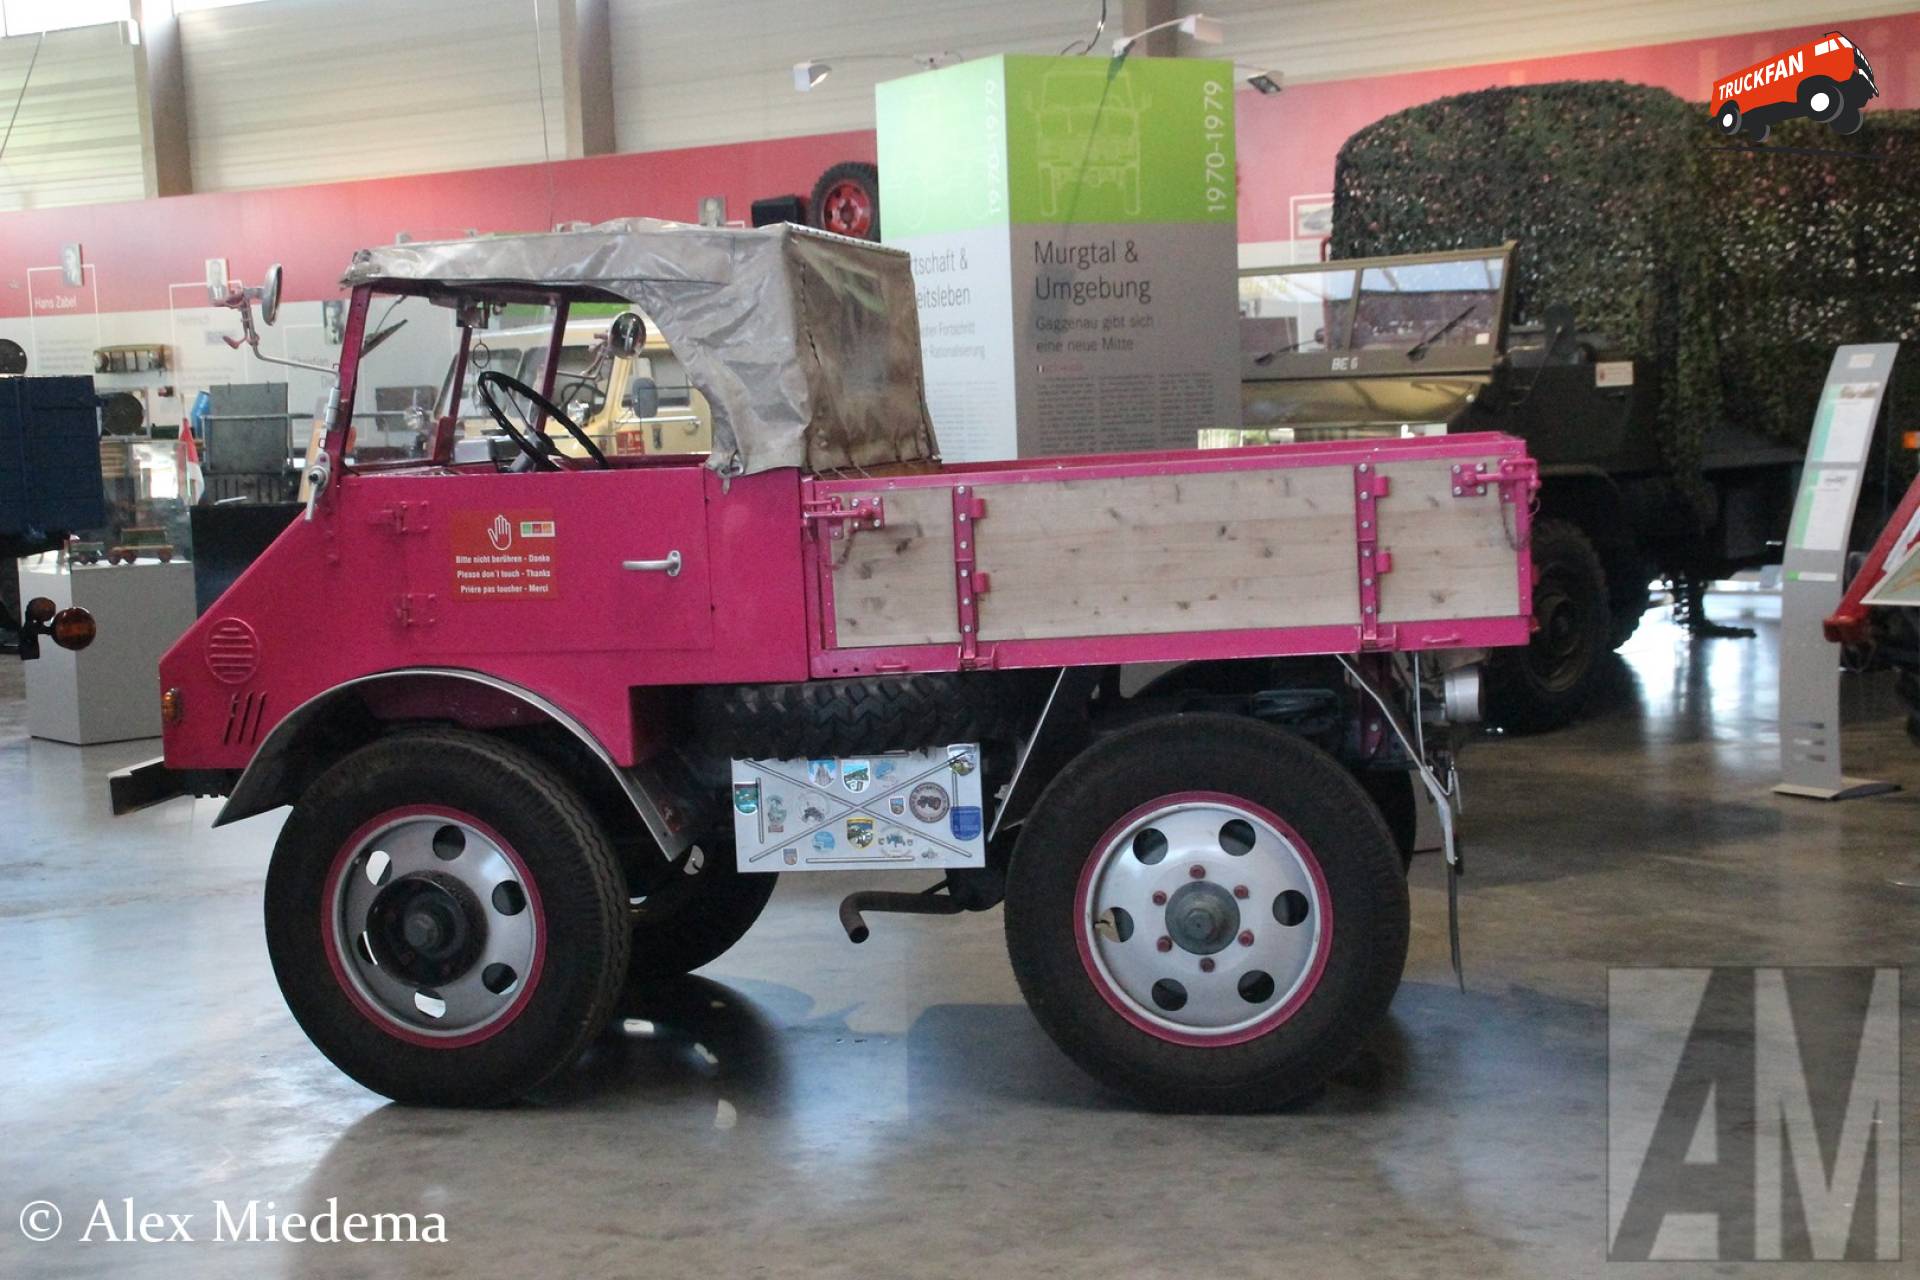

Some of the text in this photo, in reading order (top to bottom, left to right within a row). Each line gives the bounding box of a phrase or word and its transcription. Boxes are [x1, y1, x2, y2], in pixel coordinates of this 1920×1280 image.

[1204, 80, 1227, 213] 1970-1979
[1034, 240, 1139, 271] Murgtal &
[1035, 275, 1152, 306] Umgebung
[528, 554, 551, 563] Danke
